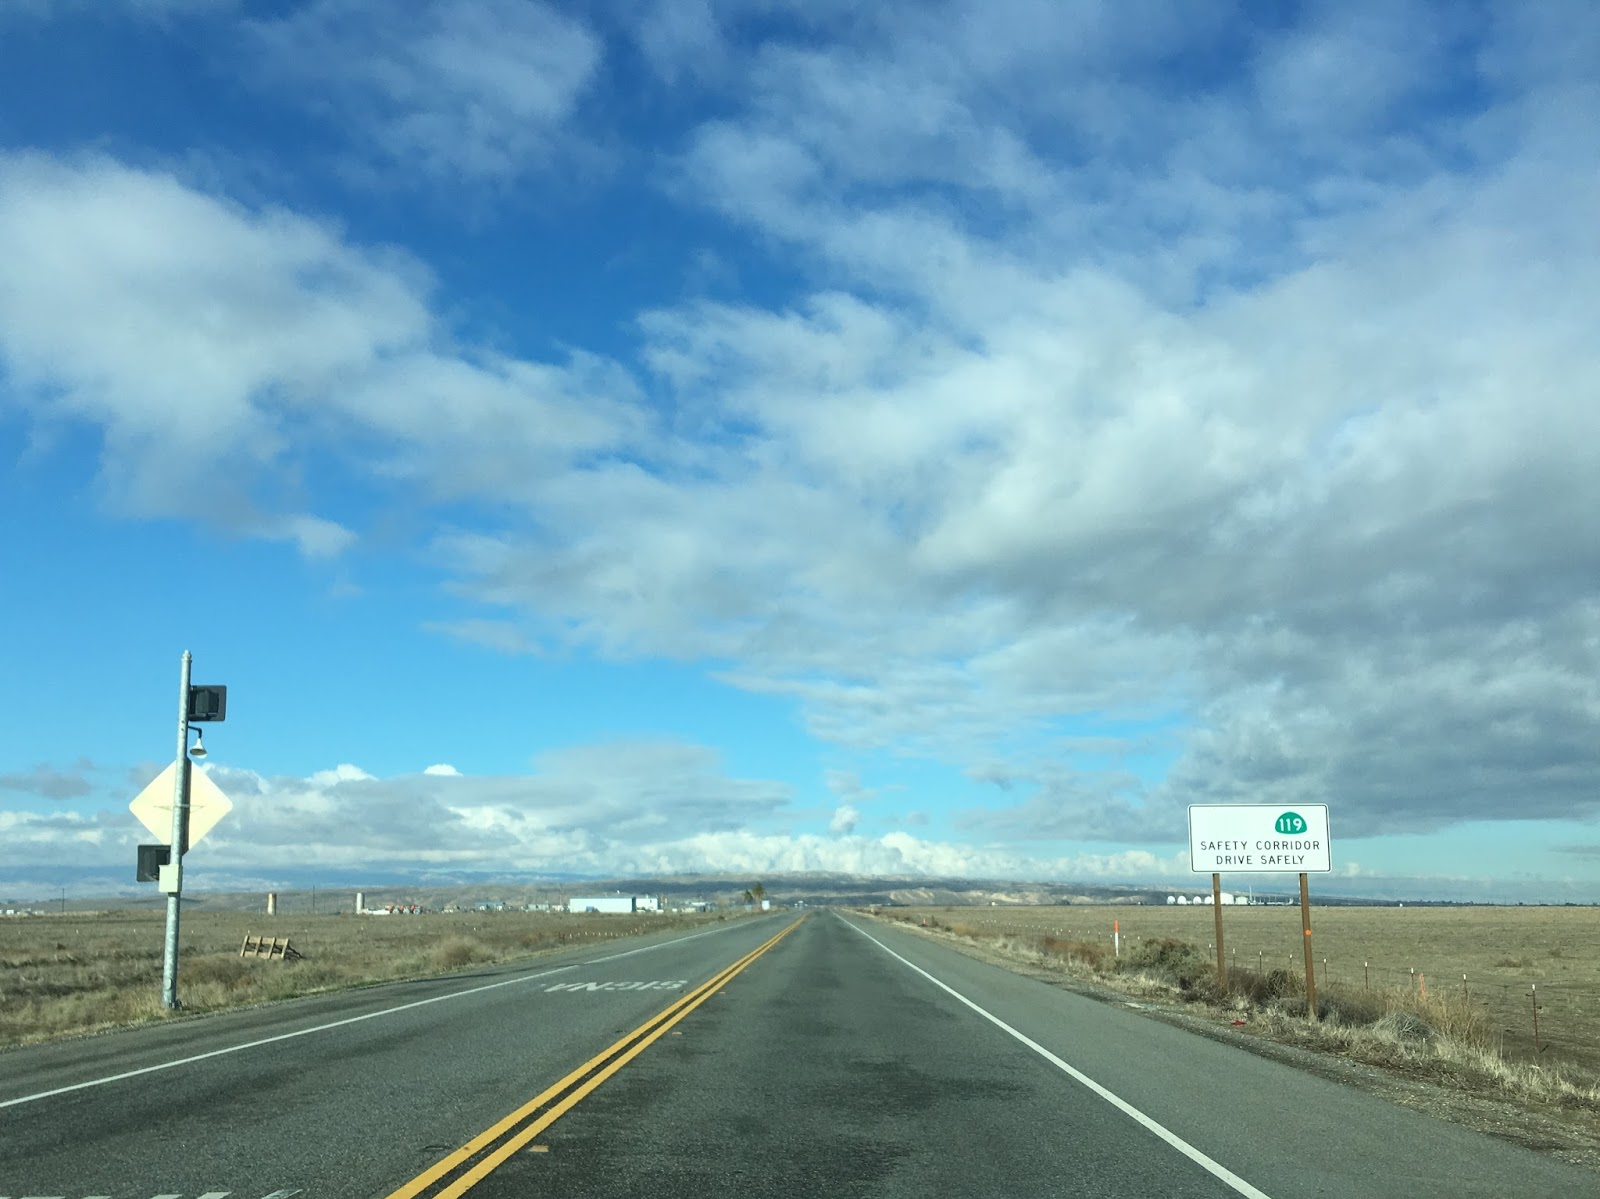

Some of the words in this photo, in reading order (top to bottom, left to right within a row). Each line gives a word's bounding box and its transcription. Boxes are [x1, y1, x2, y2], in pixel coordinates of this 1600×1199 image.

[1279, 818, 1303, 832] 119
[1200, 840, 1248, 850] SAFETY
[1255, 840, 1320, 850] CORRIDOR
[1216, 855, 1253, 865] DRIVE
[1260, 855, 1305, 865] SAFELY
[540, 980, 688, 993] SIGNA
